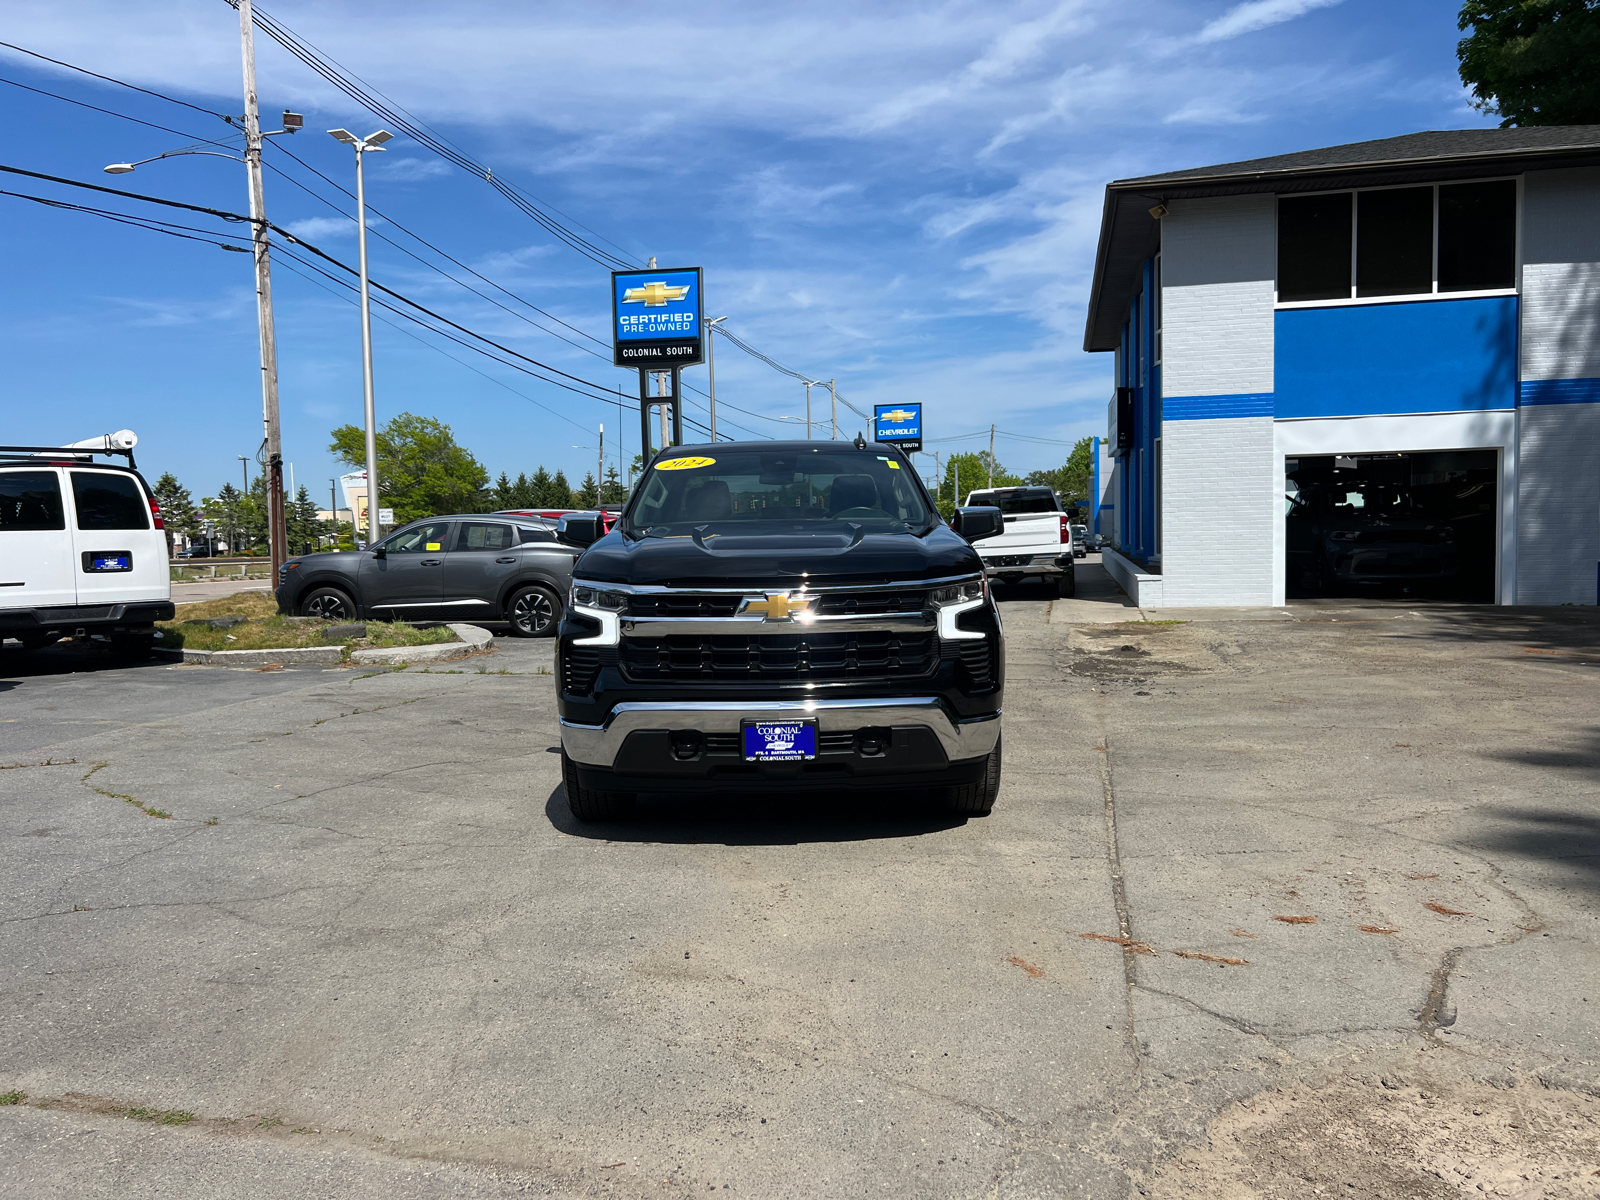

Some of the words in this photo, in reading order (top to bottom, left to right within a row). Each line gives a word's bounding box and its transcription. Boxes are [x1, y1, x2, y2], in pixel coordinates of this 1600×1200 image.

[620, 312, 694, 324] CERTIFIED
[624, 322, 690, 333] PRE-OWNED
[622, 348, 662, 357] COLONIAL
[666, 346, 693, 355] SOUTH
[664, 458, 708, 468] 2024
[758, 726, 802, 735] COLONIAL
[764, 734, 794, 742] SOUTH
